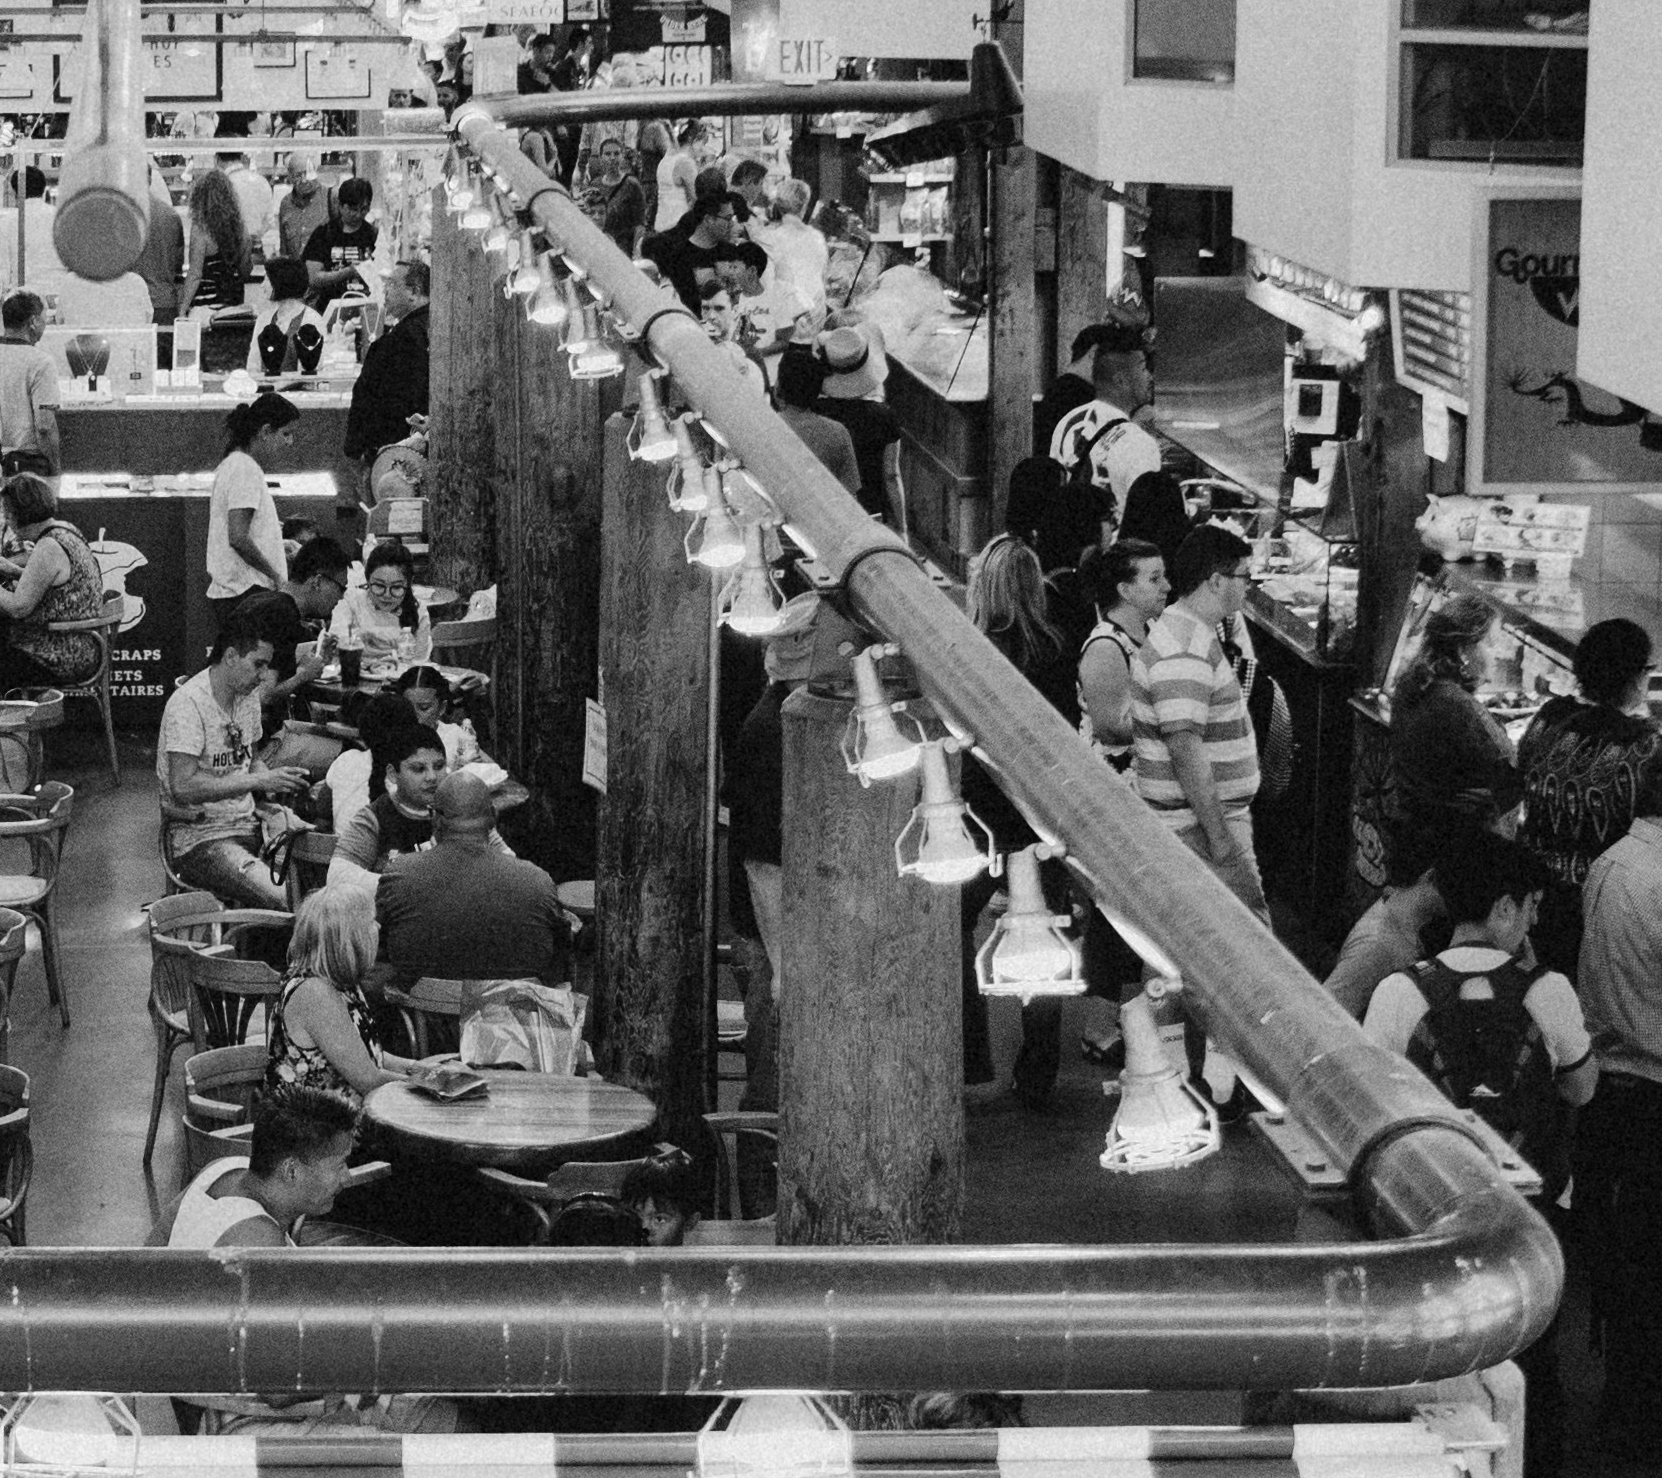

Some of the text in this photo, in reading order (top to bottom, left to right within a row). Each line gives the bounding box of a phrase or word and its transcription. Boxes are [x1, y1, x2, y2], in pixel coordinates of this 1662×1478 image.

[778, 40, 824, 73] EXIT
[1496, 248, 1579, 285] Gour
[112, 649, 162, 662] CRAPS
